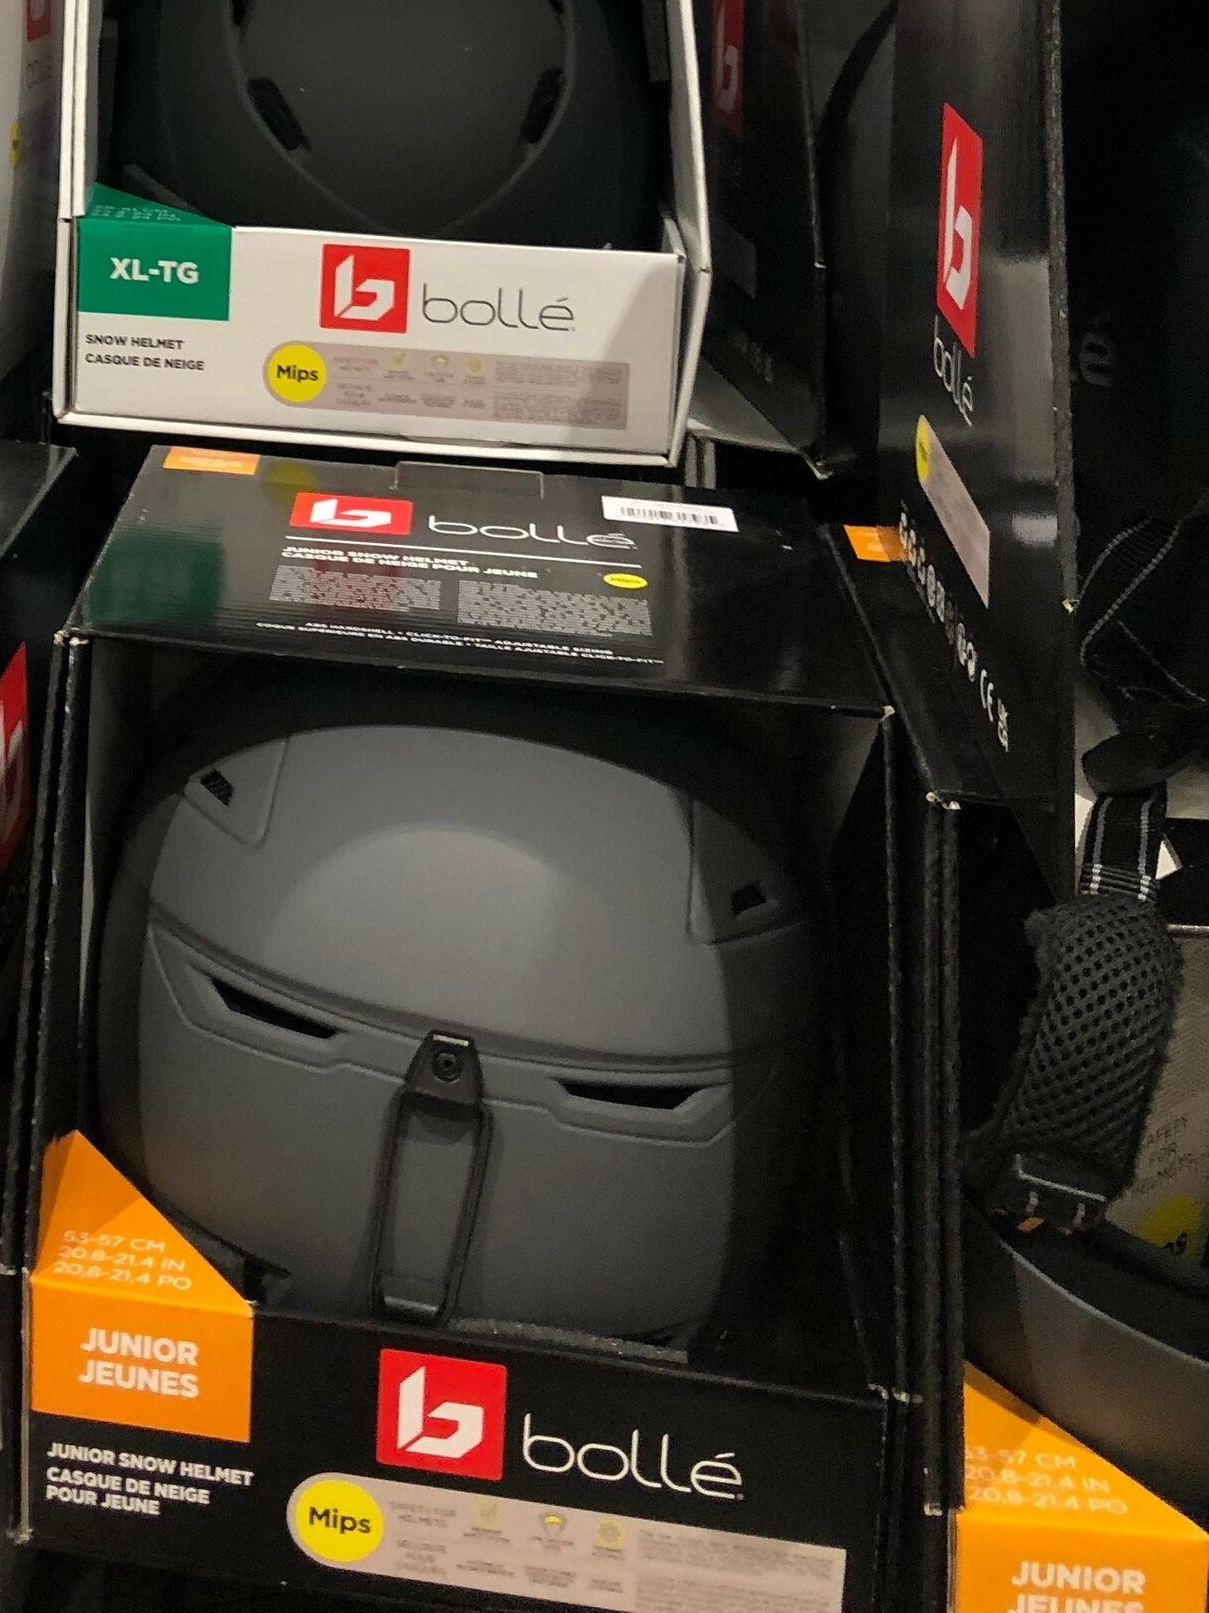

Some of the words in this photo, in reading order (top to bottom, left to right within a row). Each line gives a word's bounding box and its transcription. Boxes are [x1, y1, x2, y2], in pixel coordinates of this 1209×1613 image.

[110, 257, 199, 284] XL-TG
[422, 282, 573, 332] bollé
[85, 334, 127, 347] SNOW
[131, 337, 184, 350] HELMET
[85, 353, 140, 367] CASQUE
[143, 357, 161, 369] DE
[164, 359, 204, 371] NEIGE
[275, 363, 319, 383] Mips
[428, 515, 636, 550] bollé
[281, 551, 352, 563] CASQUE
[353, 556, 377, 565] DE
[378, 558, 430, 570] NEIGE
[432, 562, 480, 574] POUR
[482, 568, 539, 579] JEUNE
[282, 546, 344, 558] JUNIOR
[346, 550, 400, 561] SNOW
[401, 555, 469, 566] HELMET
[62, 1230, 125, 1248] 53-57
[130, 1237, 166, 1252] CM
[59, 1245, 156, 1269] 20.8-21.4
[161, 1258, 186, 1272] IN
[157, 1275, 193, 1291] PO
[80, 1327, 199, 1367] JUNIOR
[78, 1359, 199, 1398] JEUNES
[47, 1442, 116, 1466] JUNIOR
[118, 1451, 178, 1474] SNOW
[180, 1461, 254, 1486] HELMET
[522, 1412, 743, 1500] bollé
[1035, 1453, 1077, 1470] CM
[46, 1466, 123, 1490] CASQUE
[126, 1477, 151, 1496] DE
[154, 1480, 211, 1505] NEIGE
[1082, 1476, 1111, 1494] IN
[46, 1485, 97, 1506] POUR
[100, 1492, 161, 1516] JEUNE
[1087, 1497, 1129, 1516] PO
[308, 1506, 372, 1535] Mips
[1011, 1560, 1147, 1595] JUNIOR
